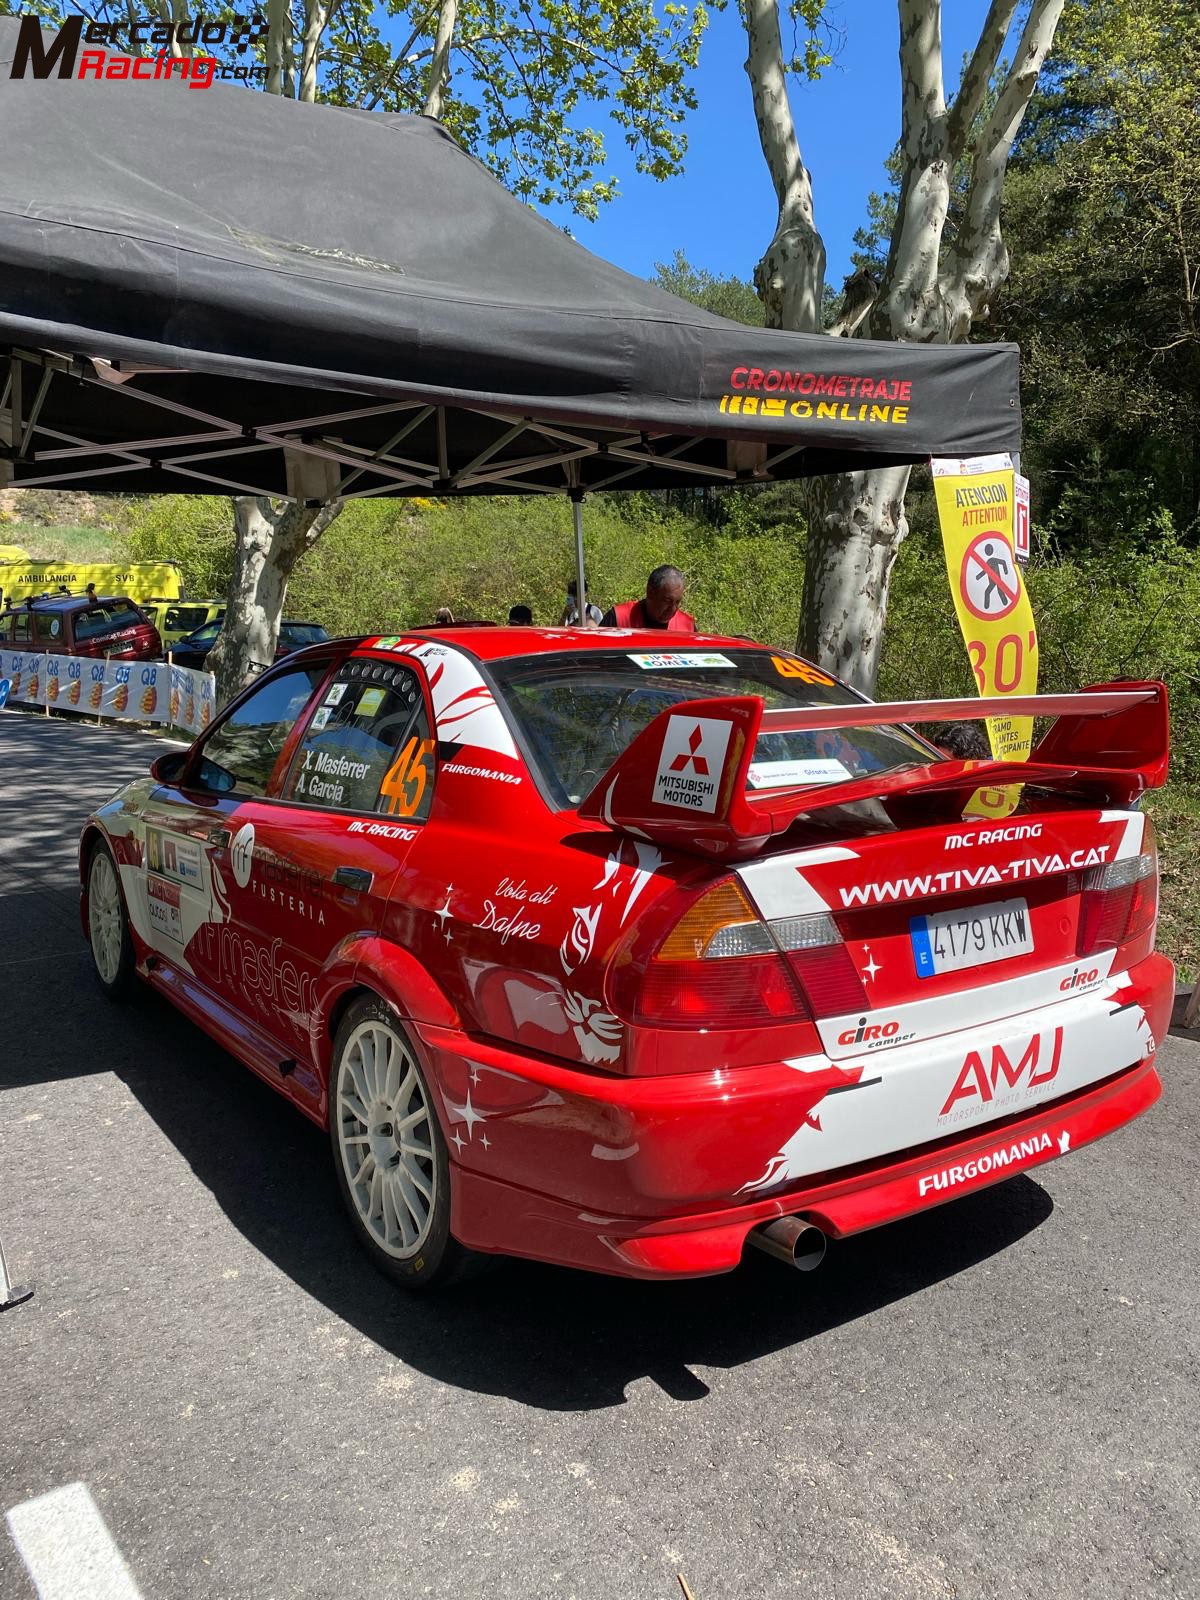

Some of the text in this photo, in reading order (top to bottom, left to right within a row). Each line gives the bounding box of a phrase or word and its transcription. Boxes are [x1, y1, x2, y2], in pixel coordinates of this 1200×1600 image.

[730, 366, 913, 401] CRONOMETRAJE
[790, 399, 910, 424] ONLINE
[955, 484, 1008, 509] ATENCION
[962, 505, 1008, 527] ATTENTION
[18, 574, 135, 583] AMBULANCIA SVB
[12, 656, 23, 672] Q8
[47, 660, 59, 676] Q8
[68, 661, 80, 679] Q8
[91, 664, 105, 681] Q8
[115, 666, 131, 684] Q8
[141, 667, 157, 686] Q8
[770, 656, 835, 687] 45
[302, 750, 370, 780] X. Masferrer
[380, 736, 435, 816] 45
[441, 763, 522, 785] FURGOMANIA
[295, 773, 306, 793] A.
[658, 775, 714, 795] MITSUBISHI
[663, 789, 703, 807] MOTORS
[347, 821, 417, 841] MC RACING
[944, 823, 1042, 850] MC RACING
[839, 845, 1110, 907] WWW.TIVA-TIVA.CAT
[252, 880, 326, 926] FUSTERIA
[473, 900, 541, 945] Dafne
[934, 910, 1027, 959] 4179 KKW
[920, 952, 928, 965] E
[868, 1031, 916, 1049] camper
[938, 1026, 1064, 1116] AMJ
[936, 1079, 1057, 1127] MOTORSPORT PHOTO SERVICE
[918, 1133, 1053, 1197] FURGOMANIA
